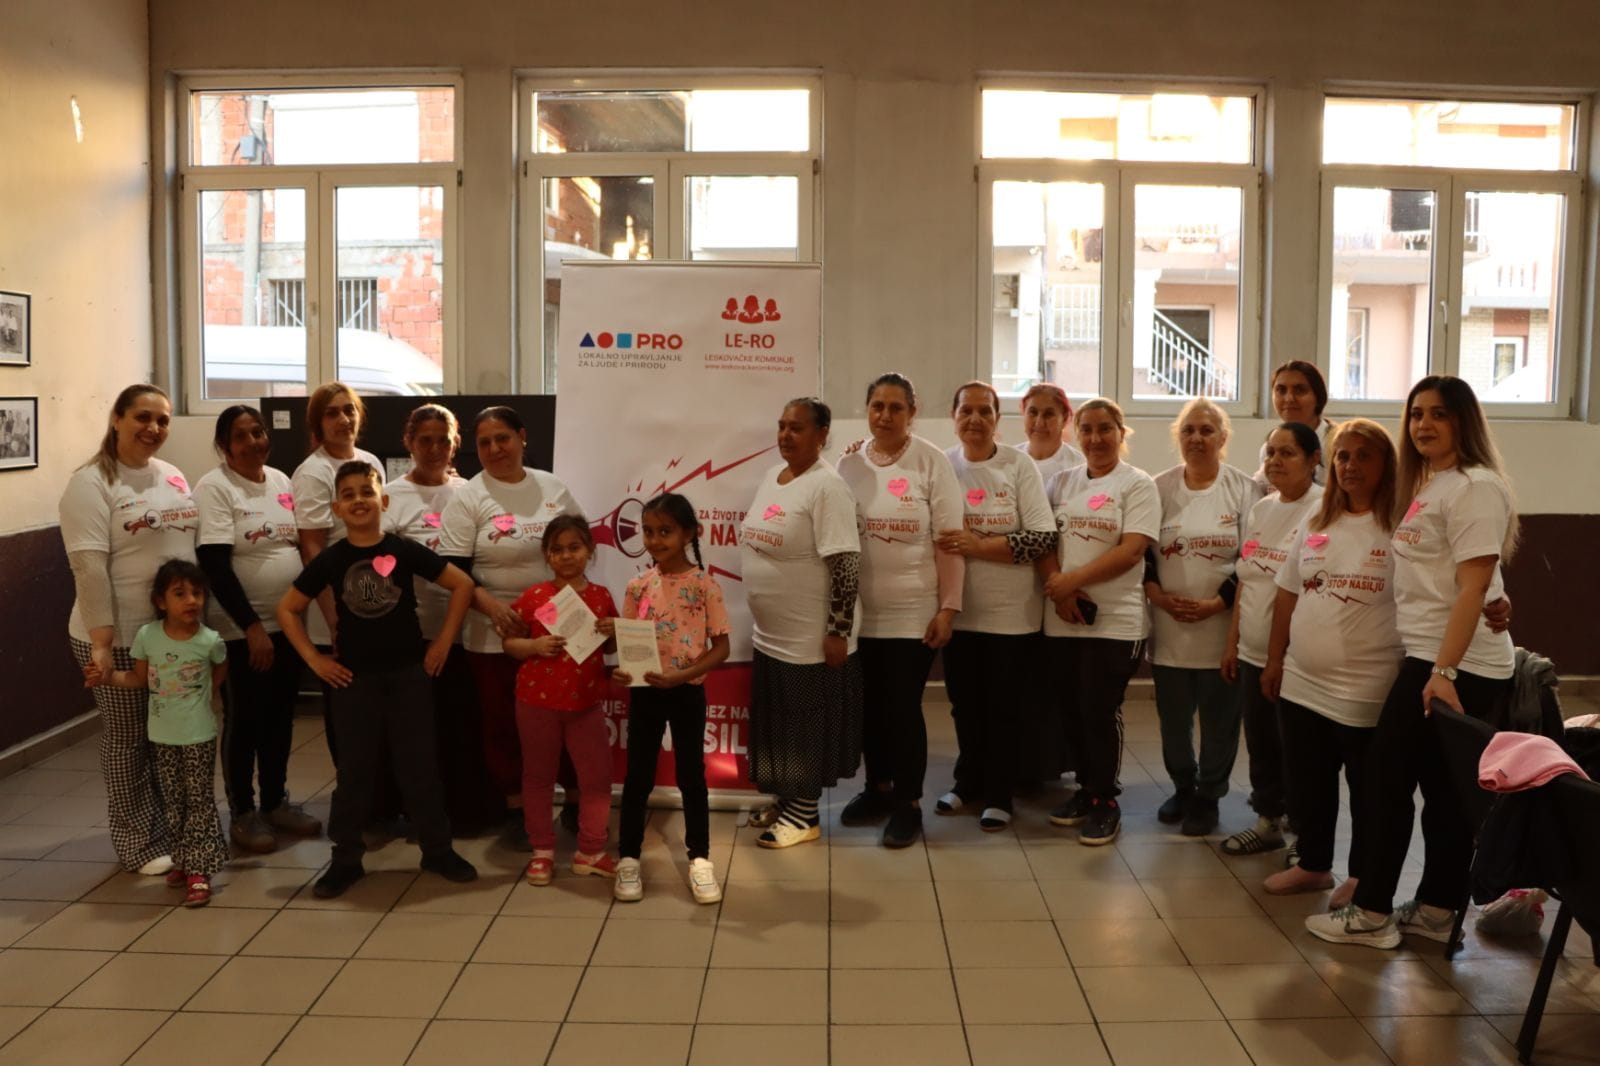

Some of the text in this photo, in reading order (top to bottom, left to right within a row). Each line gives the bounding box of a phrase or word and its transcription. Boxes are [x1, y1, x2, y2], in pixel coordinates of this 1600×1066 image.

[637, 333, 683, 350] PRO
[725, 333, 775, 349] LE-RO
[578, 352, 683, 362] LOKALNO UPRAVLJANJE
[625, 361, 666, 369] PRIRODU
[162, 512, 180, 523] STOP
[699, 509, 710, 520] ZA
[712, 507, 737, 520] ŽIVOT
[524, 525, 543, 534] STOP
[867, 522, 920, 534] STOP NASILJU
[710, 523, 738, 547] NA
[1190, 540, 1210, 550] STOP
[1328, 579, 1385, 593] STOP NASILJU
[600, 699, 750, 720] NJE: EZ NA
